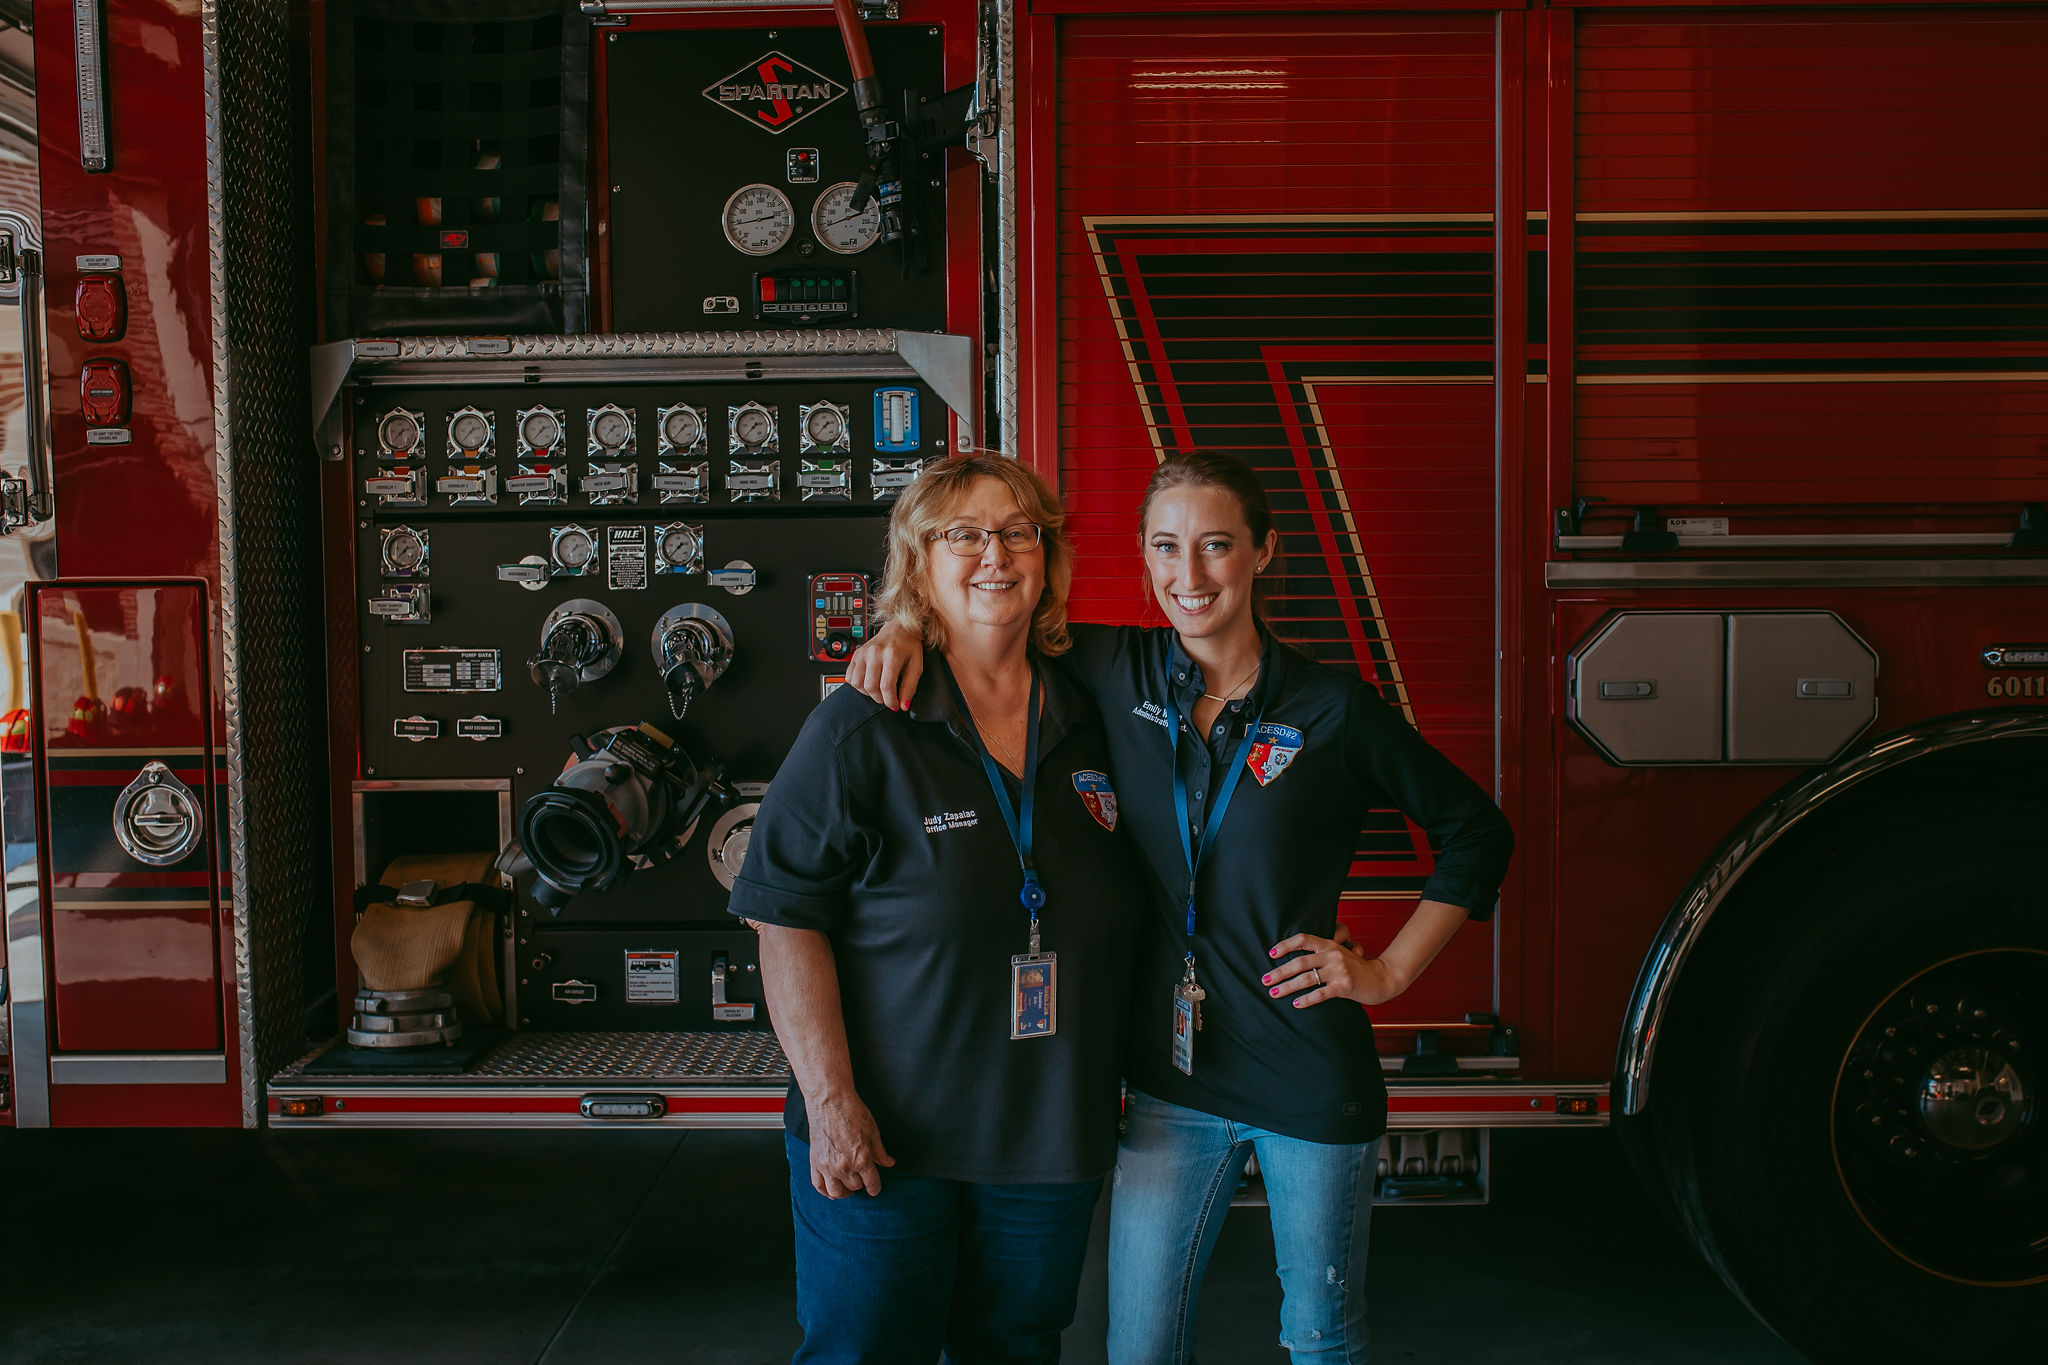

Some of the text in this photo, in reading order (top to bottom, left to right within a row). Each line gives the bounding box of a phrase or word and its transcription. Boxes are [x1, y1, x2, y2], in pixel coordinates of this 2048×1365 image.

[719, 82, 831, 101] SPARTAN
[613, 530, 640, 539] HALE
[1987, 676, 2048, 697] 6011
[1142, 700, 1162, 716] Emily
[923, 810, 976, 826] Judy Zapalac
[925, 818, 978, 834] Office Manager
